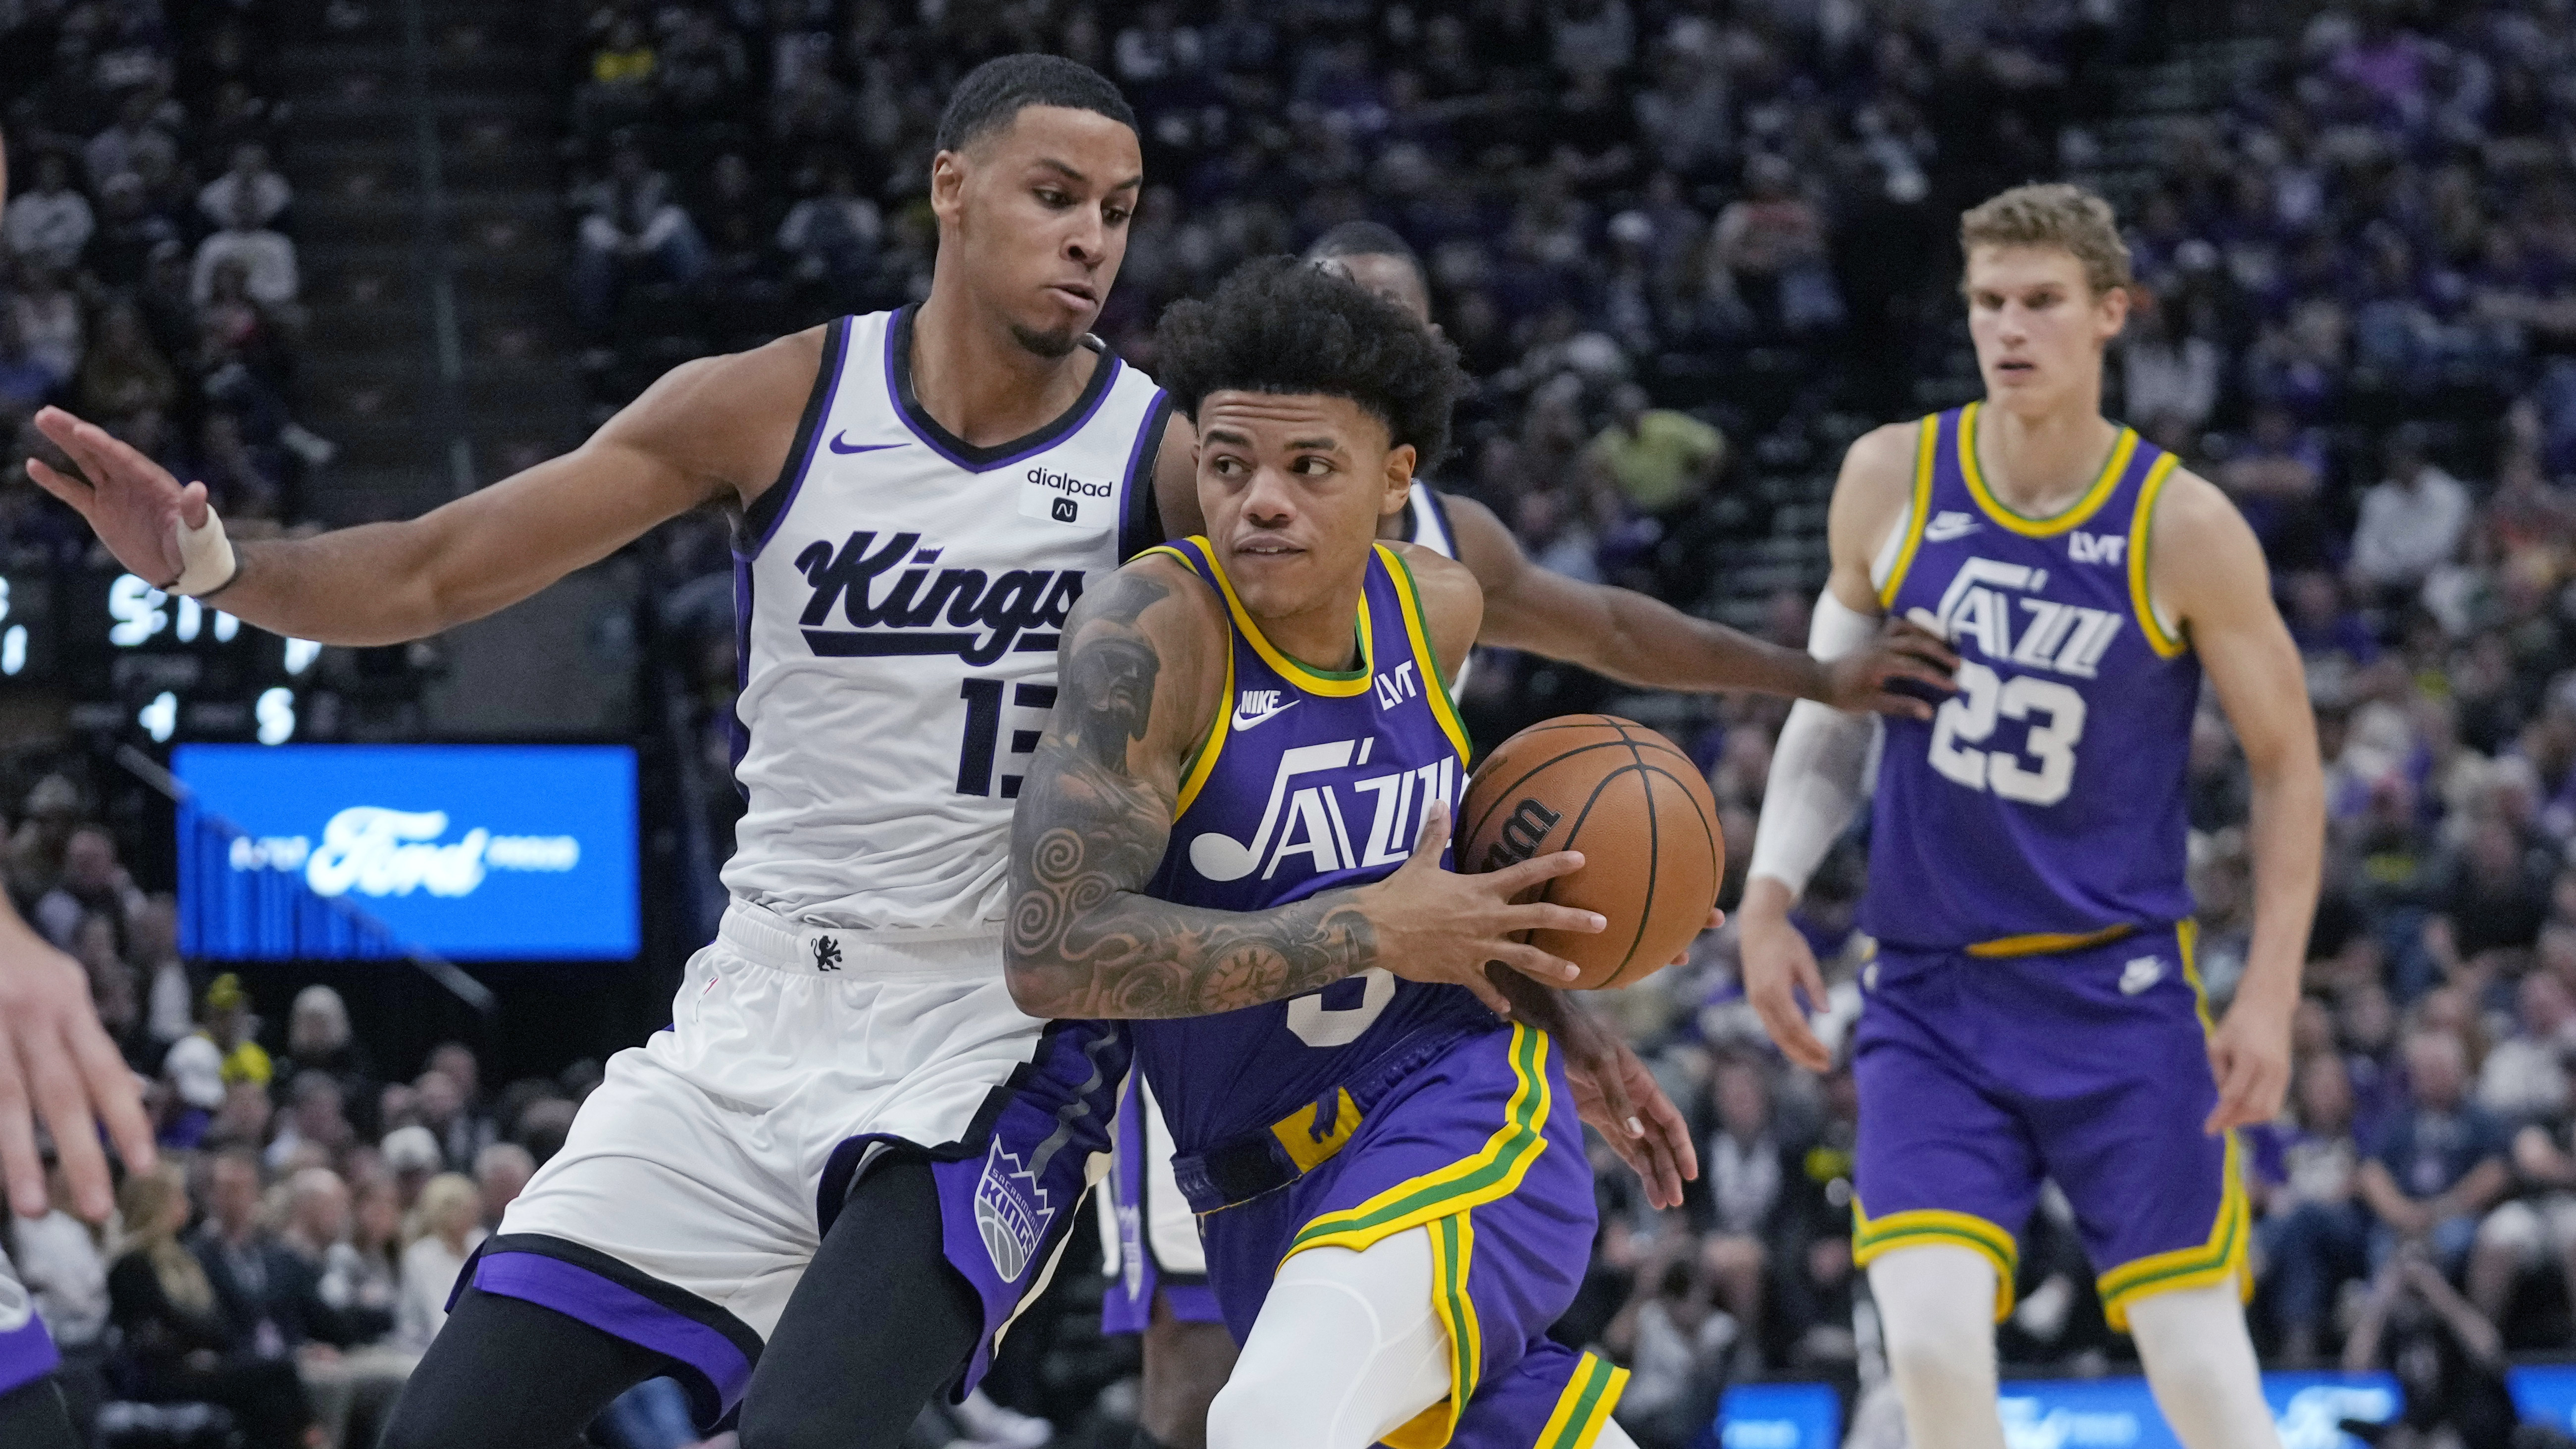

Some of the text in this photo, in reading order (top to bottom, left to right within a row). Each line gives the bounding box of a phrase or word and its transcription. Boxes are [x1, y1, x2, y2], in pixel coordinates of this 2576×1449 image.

[1028, 466, 1112, 497] dialpad
[2067, 530, 2126, 567] LVT
[794, 531, 1086, 667] Kings
[1240, 690, 1281, 714] NIKE
[1374, 660, 1417, 711] LVT
[1928, 658, 2086, 807] 23
[307, 806, 490, 897] Ford
[980, 1178, 1032, 1263] KINGS
[992, 1168, 1040, 1239] SACRAMENTO
